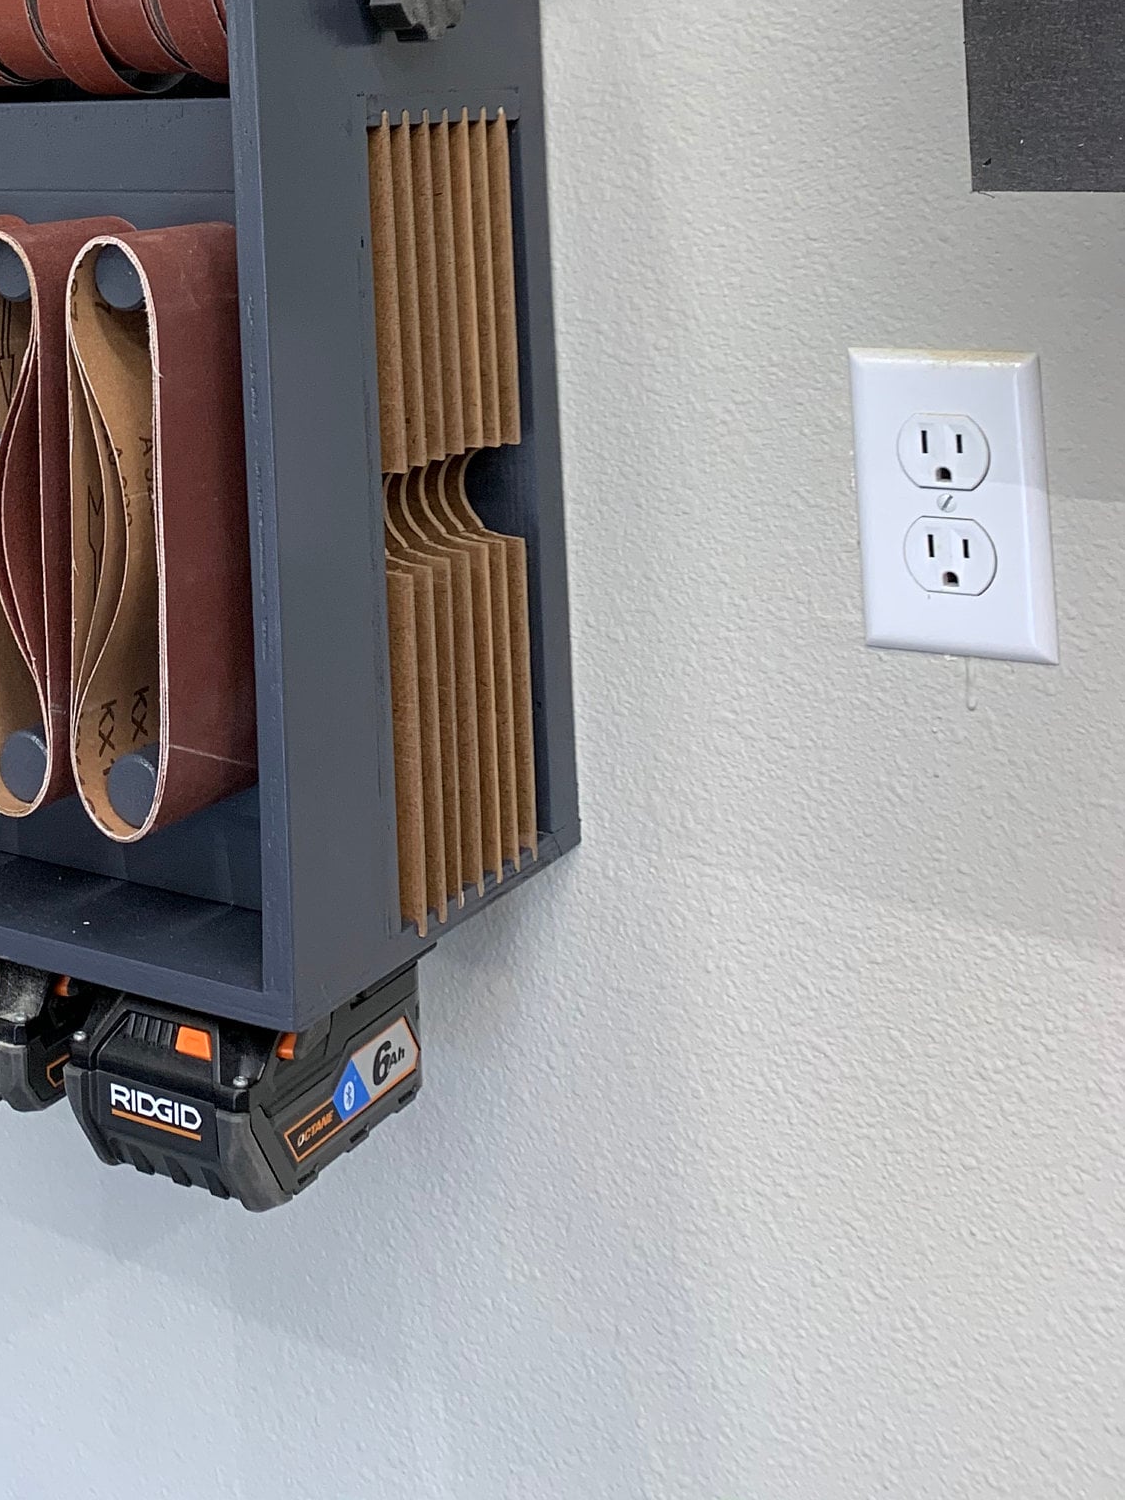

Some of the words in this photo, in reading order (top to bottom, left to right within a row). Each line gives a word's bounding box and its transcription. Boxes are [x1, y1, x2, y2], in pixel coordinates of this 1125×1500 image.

[372, 1040, 406, 1086] 6Ah
[110, 1083, 203, 1131] RIDGID
[297, 1109, 335, 1148] OCTANE
